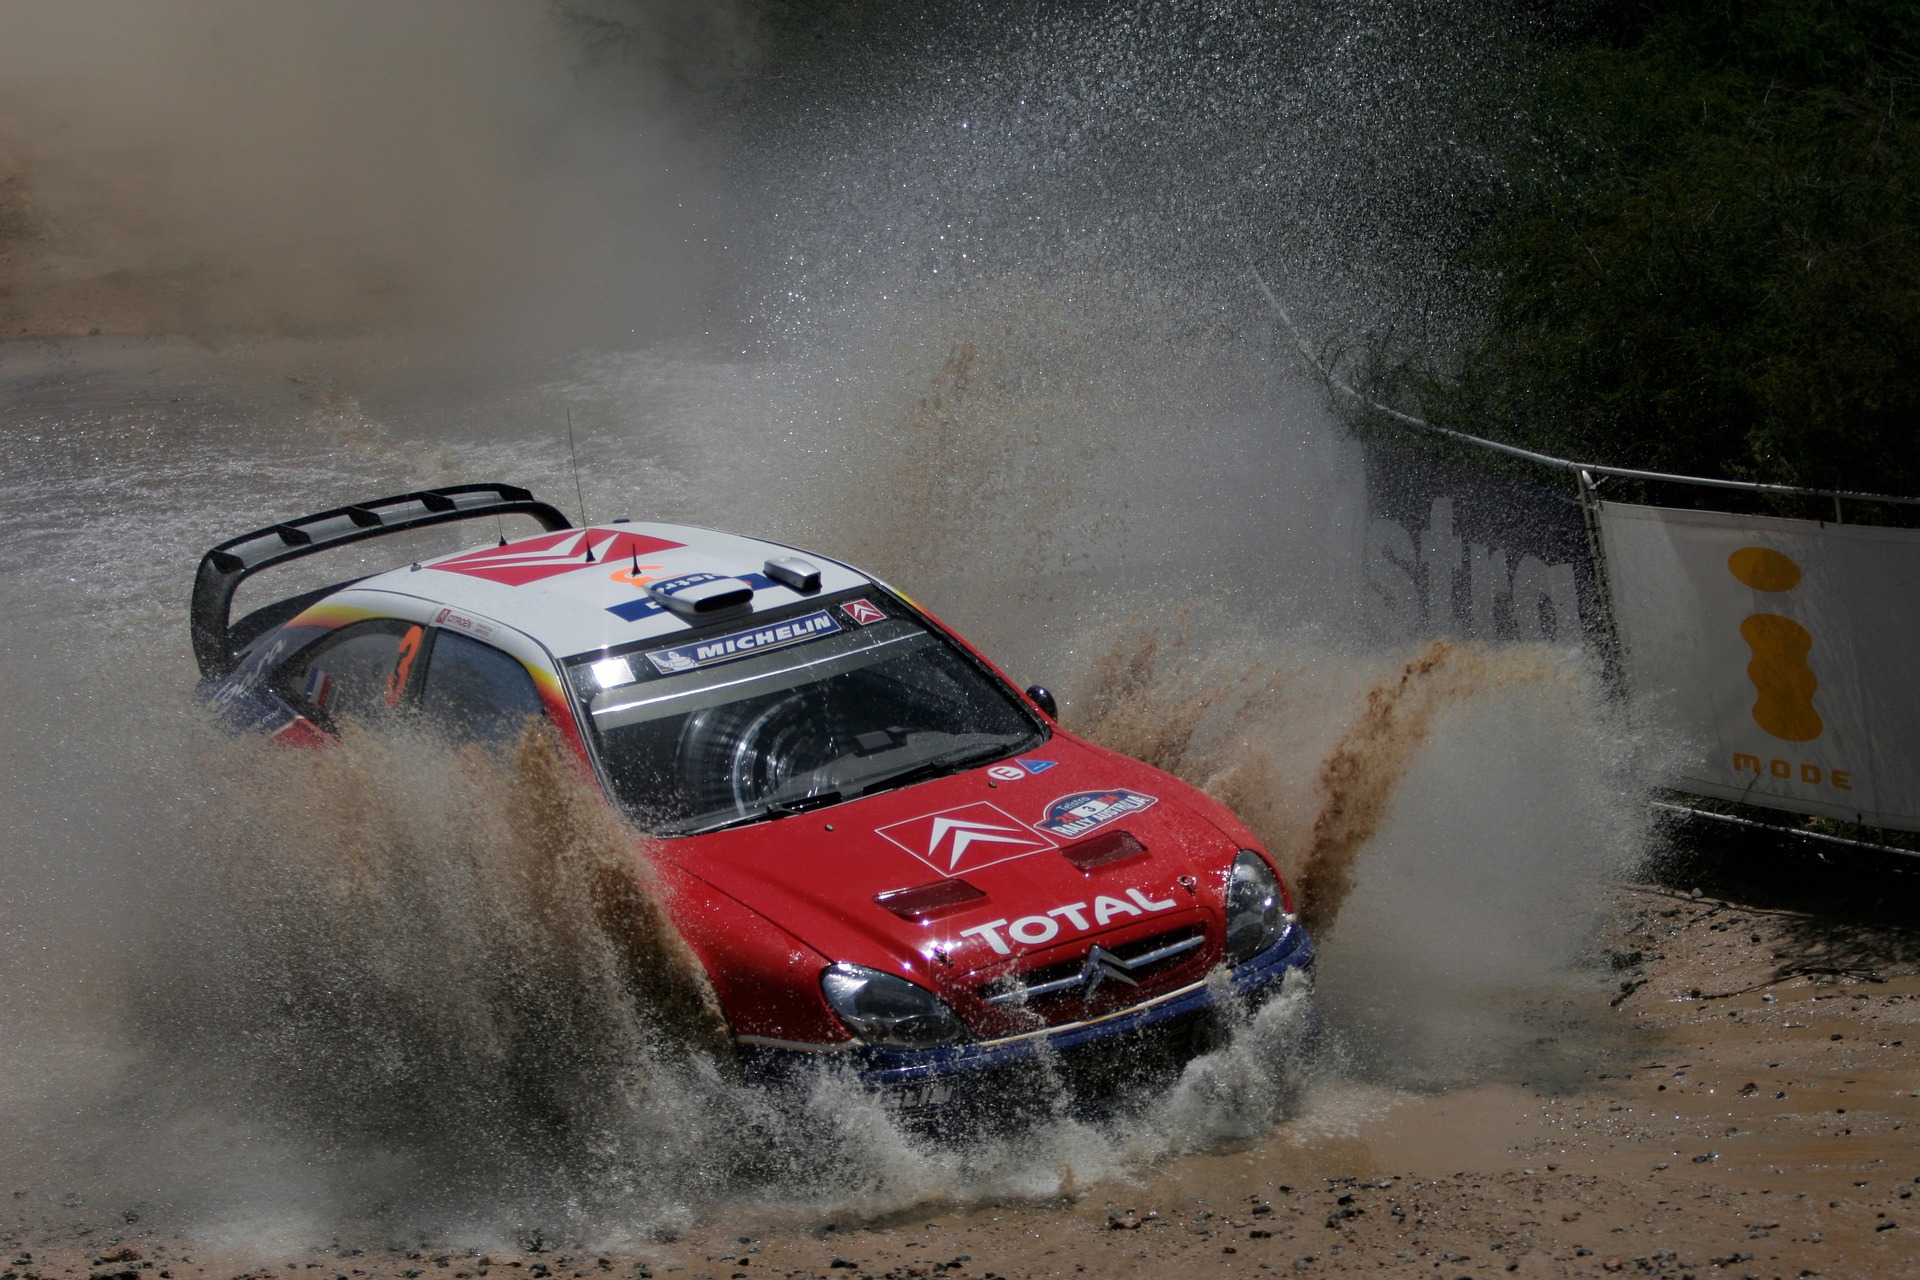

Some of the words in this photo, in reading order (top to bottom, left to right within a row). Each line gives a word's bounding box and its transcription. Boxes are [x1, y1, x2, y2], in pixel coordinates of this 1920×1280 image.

[696, 613, 832, 660] MICHELIN
[1733, 752, 1853, 791] MODE
[1051, 817, 1096, 836] RALLY
[1091, 795, 1150, 822] AUSTRALIA
[1056, 796, 1091, 811] Telstra
[960, 888, 1178, 955] TOTAL
